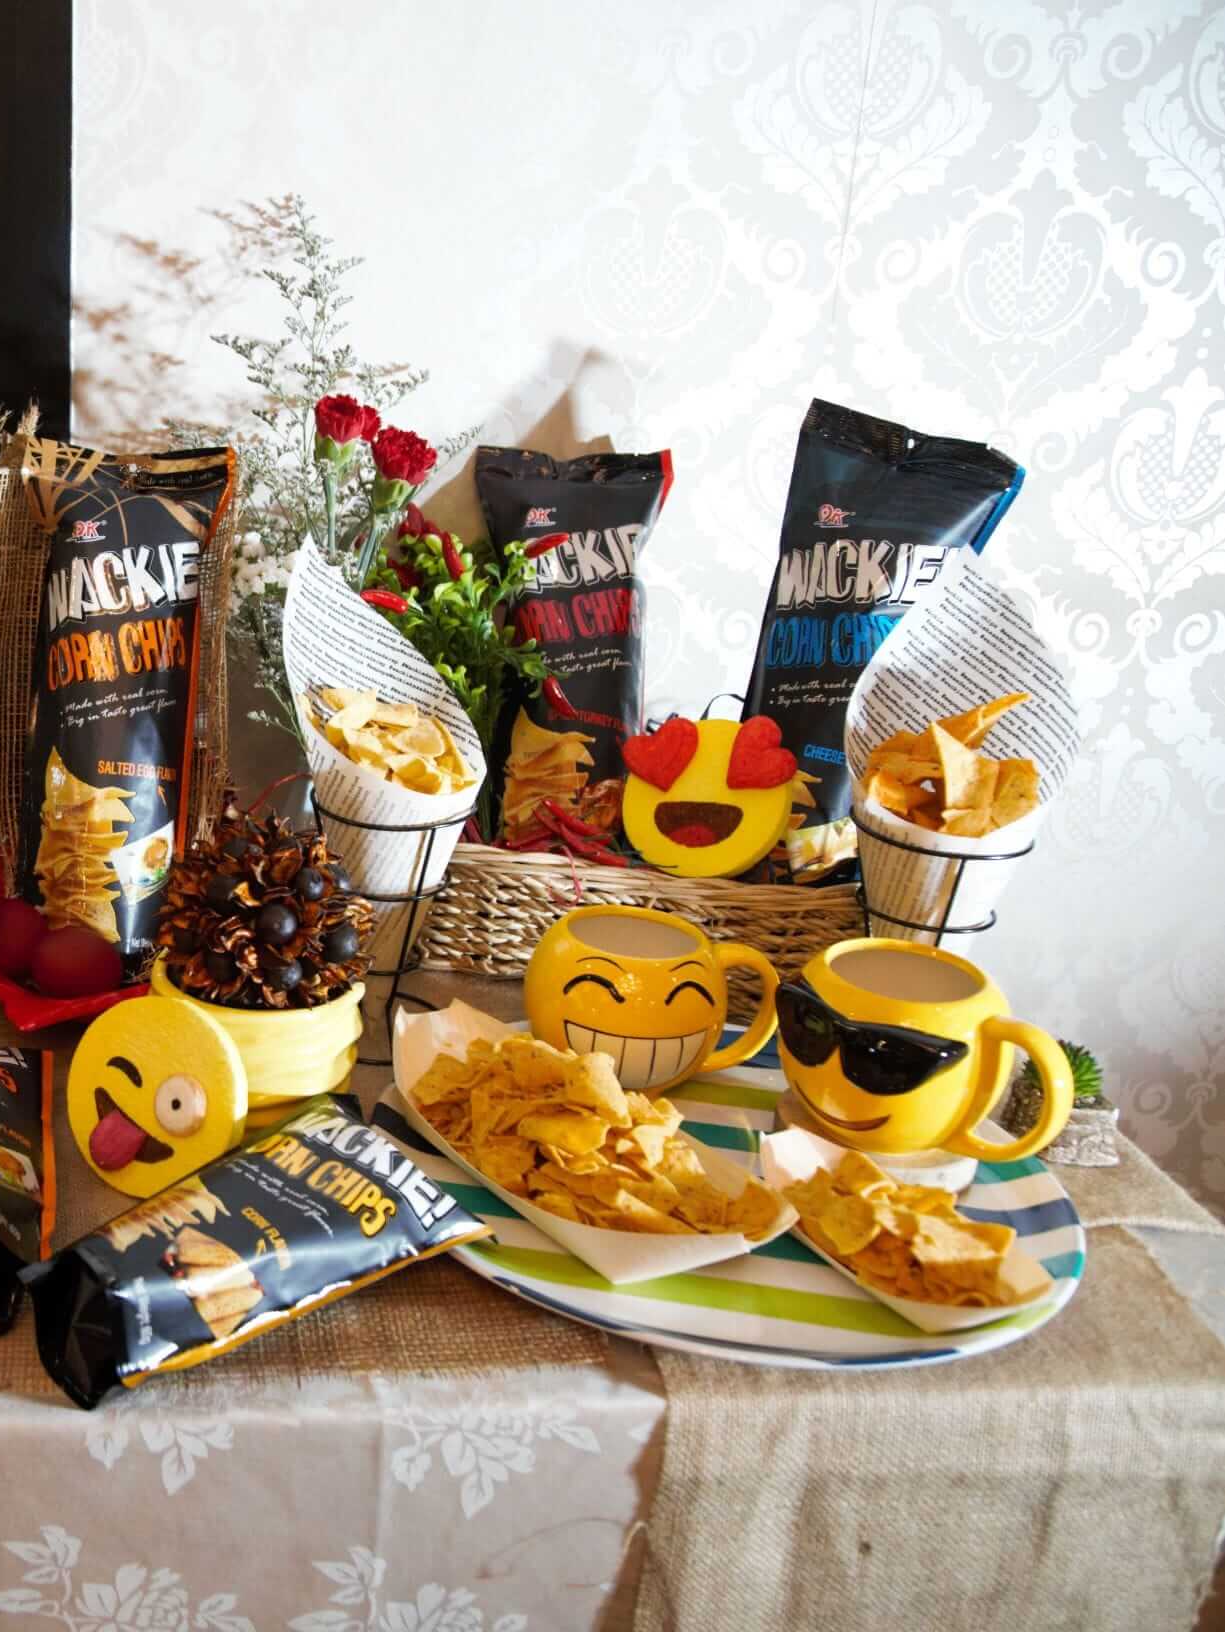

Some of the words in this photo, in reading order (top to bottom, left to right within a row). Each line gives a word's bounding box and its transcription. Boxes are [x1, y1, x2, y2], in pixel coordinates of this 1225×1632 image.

[516, 599, 573, 643] ORN
[765, 615, 826, 668] CORN
[831, 611, 903, 668] CHI
[48, 629, 118, 692] CORN
[118, 616, 186, 674] CHIPS
[554, 652, 576, 664] with
[578, 647, 598, 659] real
[823, 678, 848, 689] real
[66, 698, 93, 712] Made
[96, 692, 118, 705] with
[122, 687, 144, 700] real
[828, 695, 851, 707] grea
[67, 716, 85, 728] Big
[101, 706, 127, 718] taste
[129, 700, 156, 717] great
[803, 744, 846, 765] CHEESE
[97, 760, 135, 776] SALTED
[284, 1112, 457, 1231] WACKIE!
[247, 1134, 320, 1178] ORN
[306, 1160, 396, 1238] CHIPS
[241, 1206, 271, 1230] CORN
